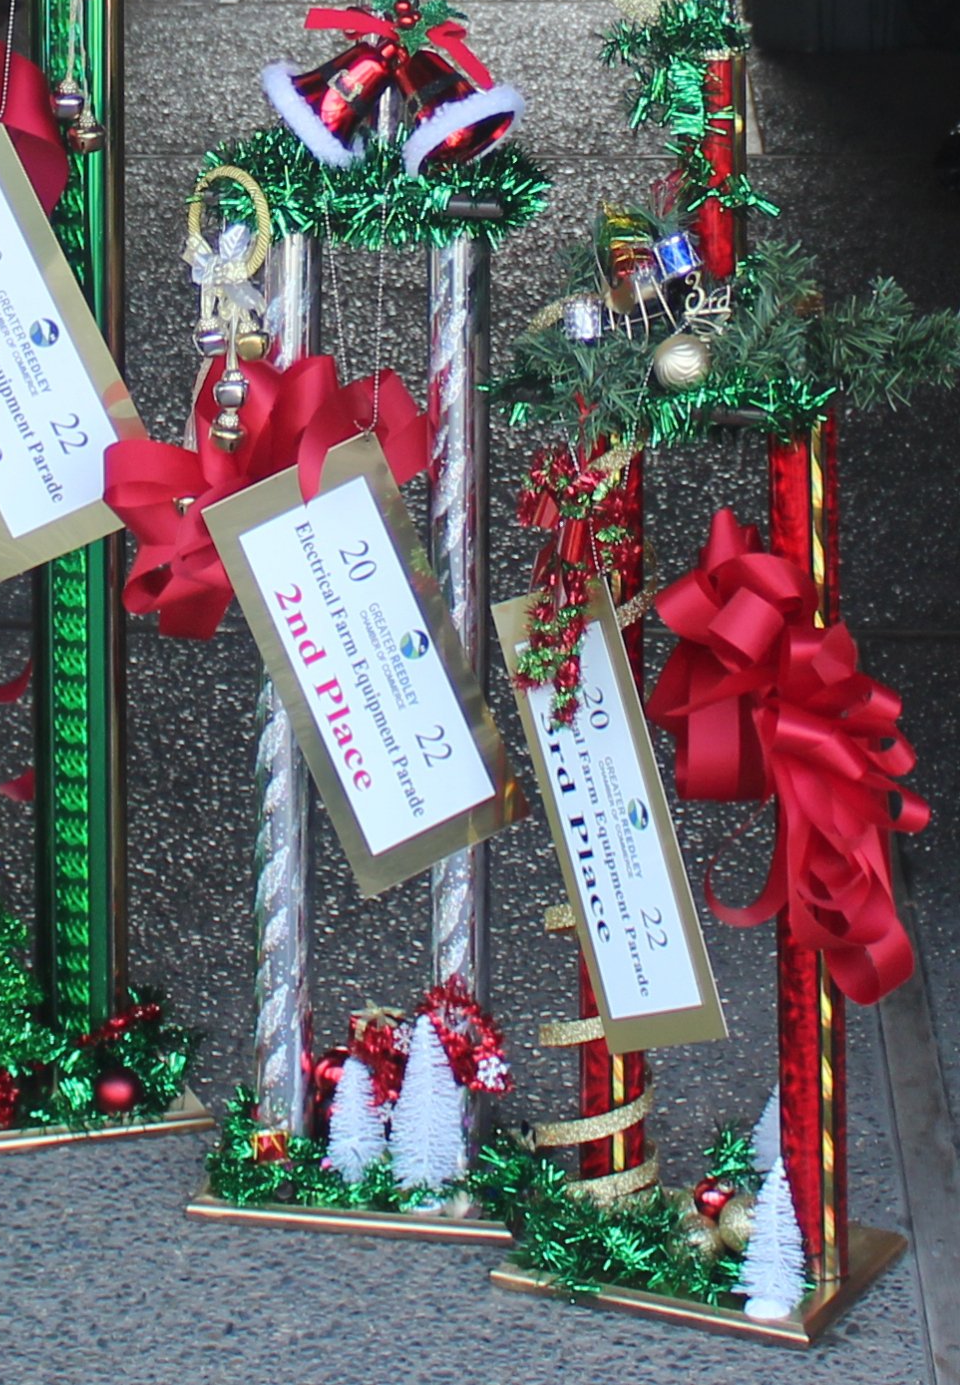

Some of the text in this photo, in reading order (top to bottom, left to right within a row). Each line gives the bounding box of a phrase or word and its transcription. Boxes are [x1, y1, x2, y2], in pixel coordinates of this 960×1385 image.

[20, 341, 52, 394] REEDLEY
[49, 412, 89, 456] 22
[27, 440, 64, 504] Parade
[273, 582, 373, 793] 2nd Place
[294, 520, 426, 818] Electrical Farm Equipment Parade
[338, 539, 453, 769] 20 22
[368, 602, 419, 707] GREATER REEDLEY
[567, 811, 611, 944] Place
[578, 749, 599, 806] Farm
[593, 809, 632, 922] Equipment
[624, 925, 650, 999] Parade
[582, 685, 669, 952] 20 22
[604, 755, 644, 878] GREATER REEDLEY
